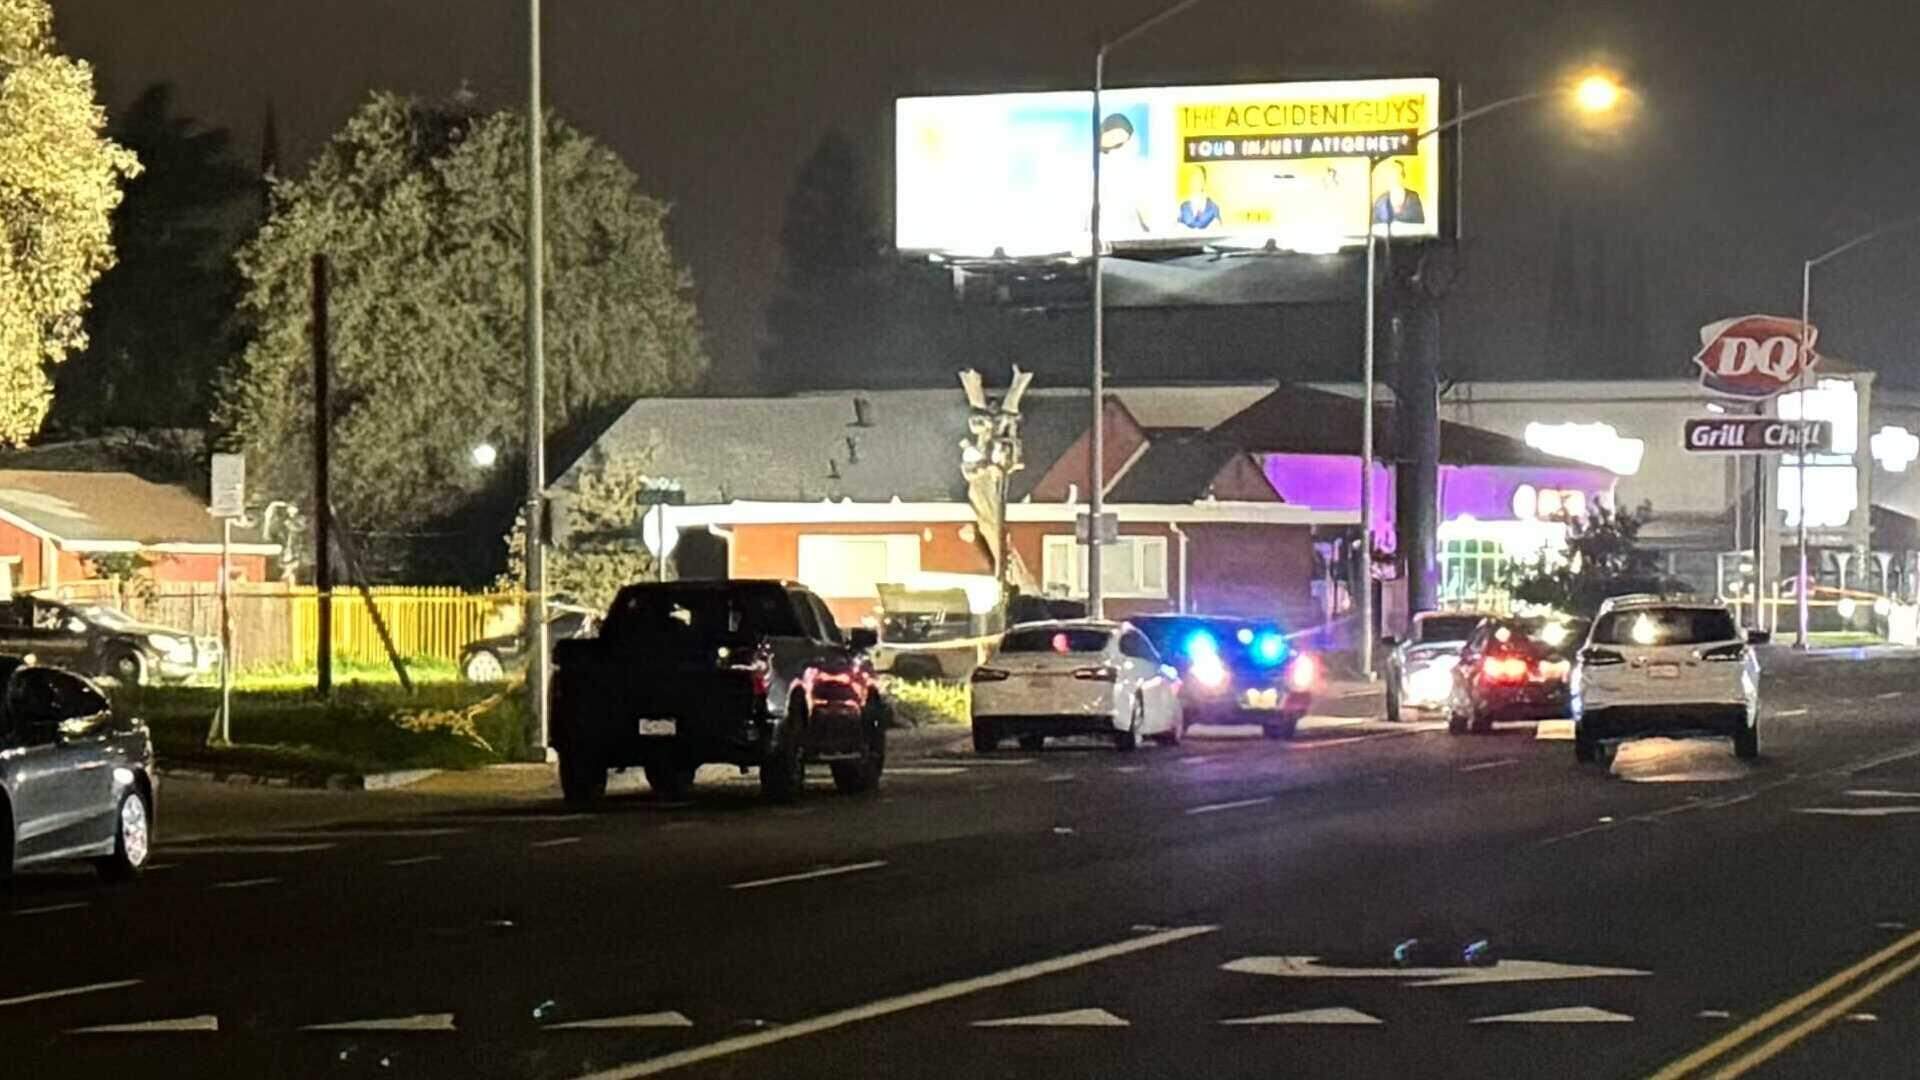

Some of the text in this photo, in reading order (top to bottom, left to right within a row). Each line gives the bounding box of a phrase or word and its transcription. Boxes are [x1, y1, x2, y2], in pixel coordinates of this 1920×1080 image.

[1716, 336, 1798, 382] DQ
[1691, 423, 1821, 447] Grill Chill
